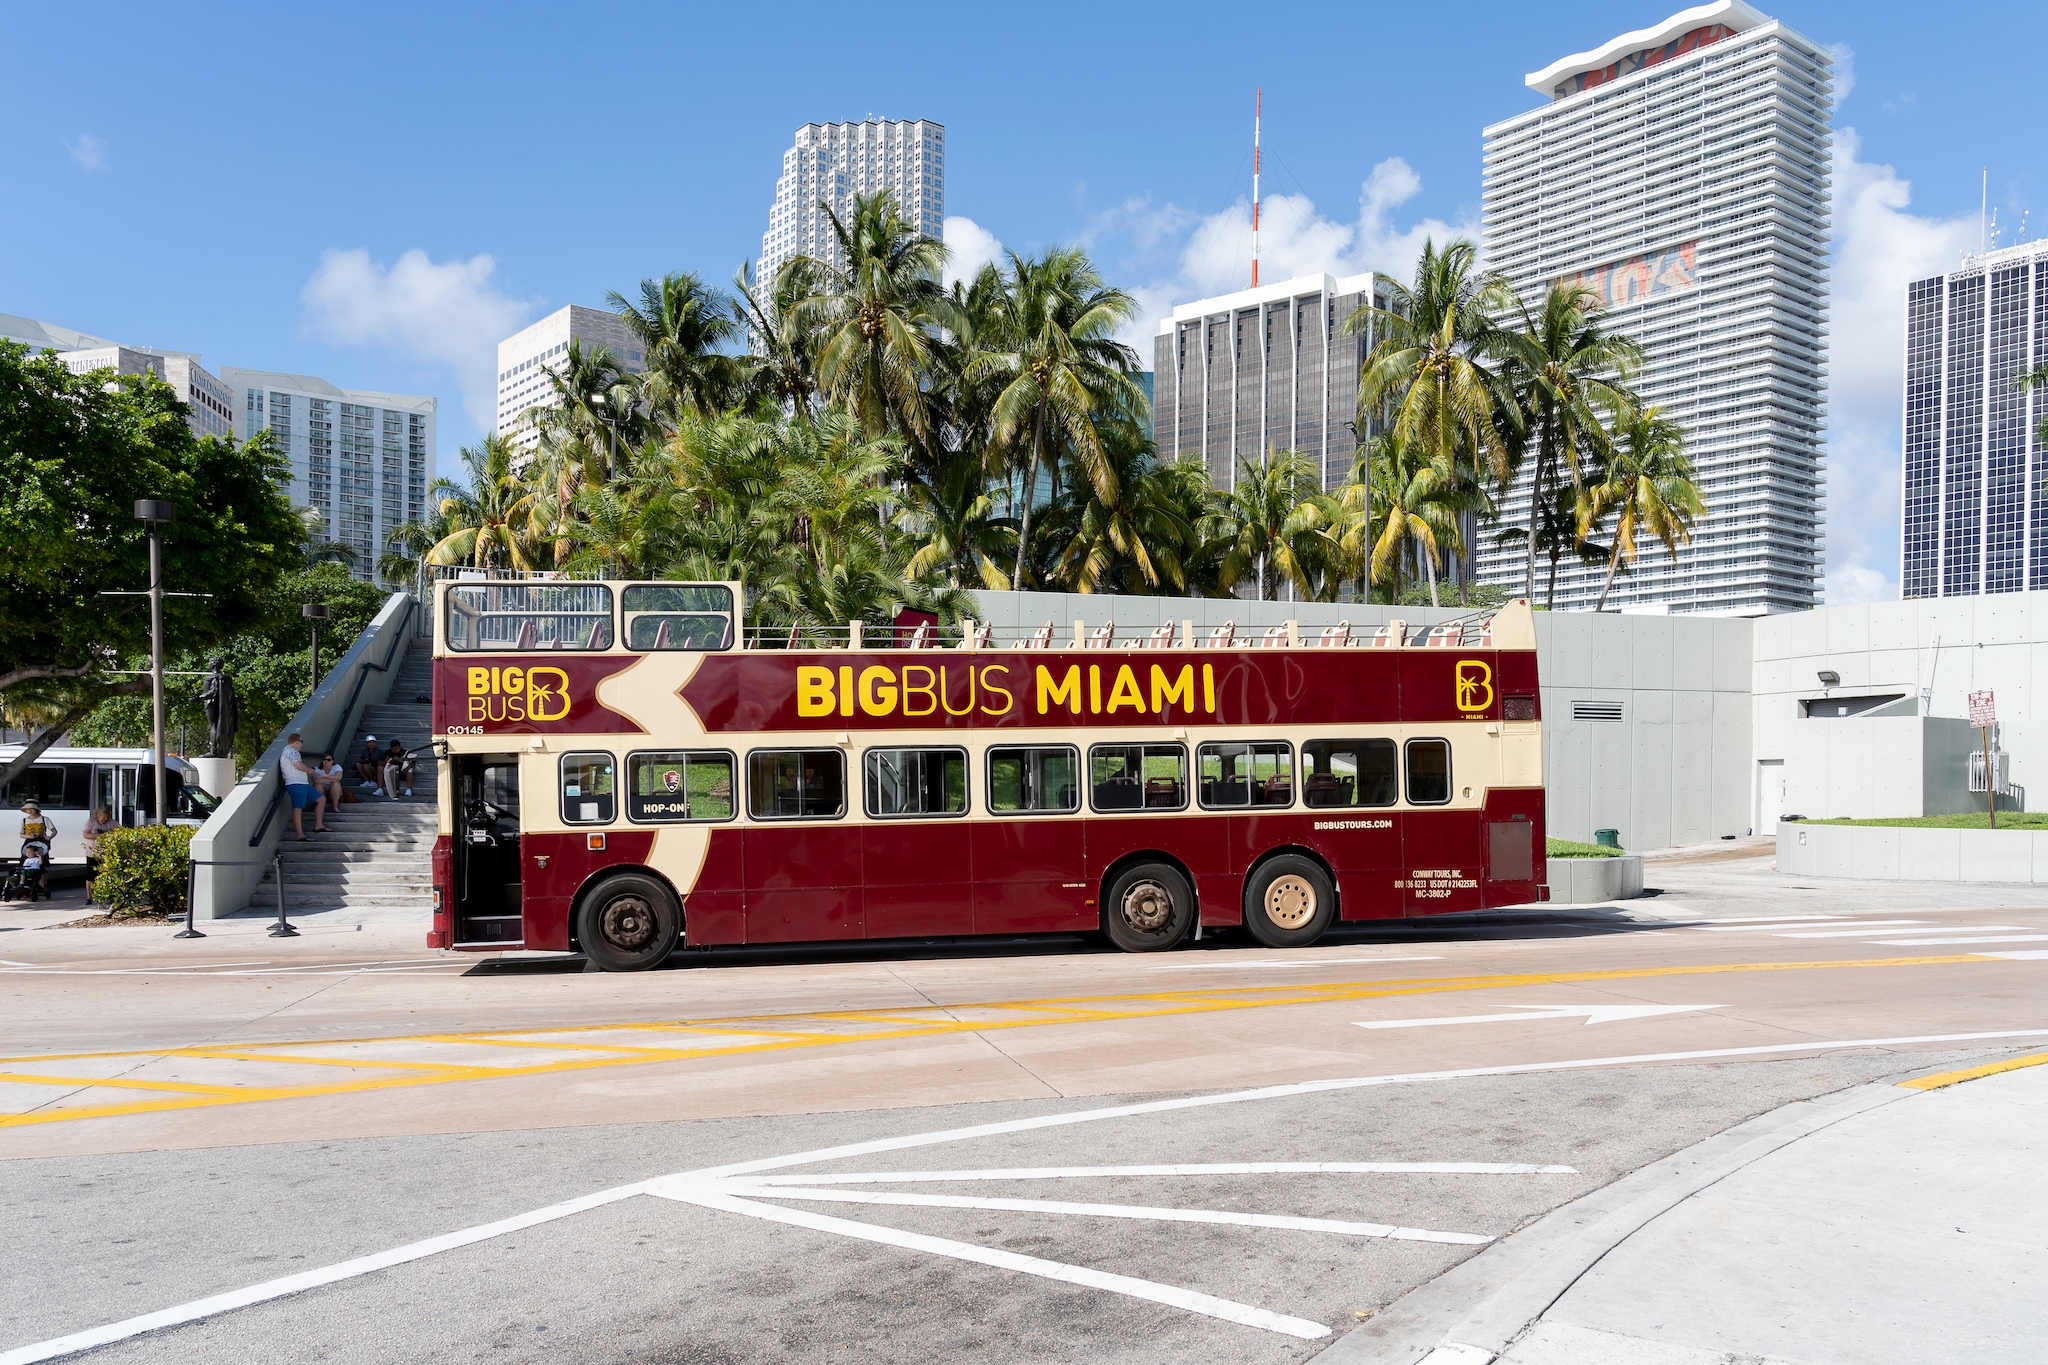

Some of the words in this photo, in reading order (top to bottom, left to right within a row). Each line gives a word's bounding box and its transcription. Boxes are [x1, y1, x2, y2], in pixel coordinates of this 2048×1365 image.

[67, 357, 115, 372] NTINENTAL
[467, 666, 525, 695] BIG
[1036, 663, 1217, 716] MIAMI
[468, 696, 526, 723] BUS
[643, 803, 685, 813] HOP-ON
[1313, 820, 1393, 830] BIGBUSTOURS.COM
[1412, 870, 1433, 879] CONWAY
[1434, 870, 1452, 879] TOURS,
[1452, 870, 1462, 878] INC.
[1394, 880, 1404, 889] 800
[1429, 880, 1437, 888] US
[1437, 880, 1448, 888] DOT
[1415, 889, 1452, 898] MC-3802-P
